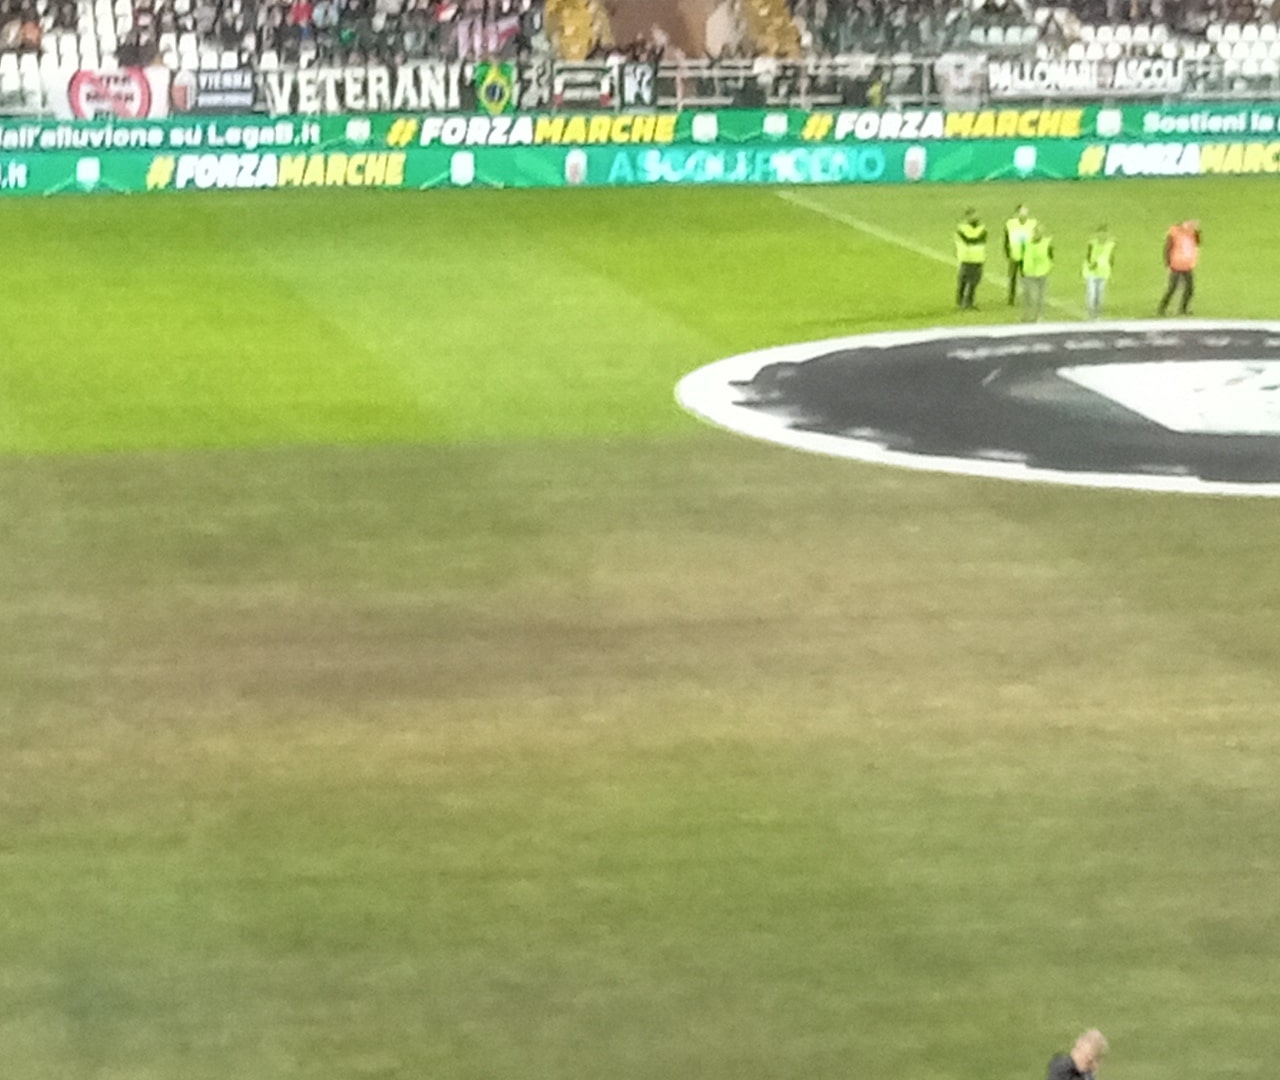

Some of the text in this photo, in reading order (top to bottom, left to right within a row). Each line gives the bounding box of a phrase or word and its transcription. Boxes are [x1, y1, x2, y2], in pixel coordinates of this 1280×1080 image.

[170, 124, 203, 147] su
[386, 114, 677, 147] #FORZAMARCHE
[801, 109, 1083, 140] #FORZAMARCHE
[1143, 110, 1248, 133] Sostieni
[1251, 110, 1274, 132] la
[146, 151, 406, 190] #FORZAMARCHE
